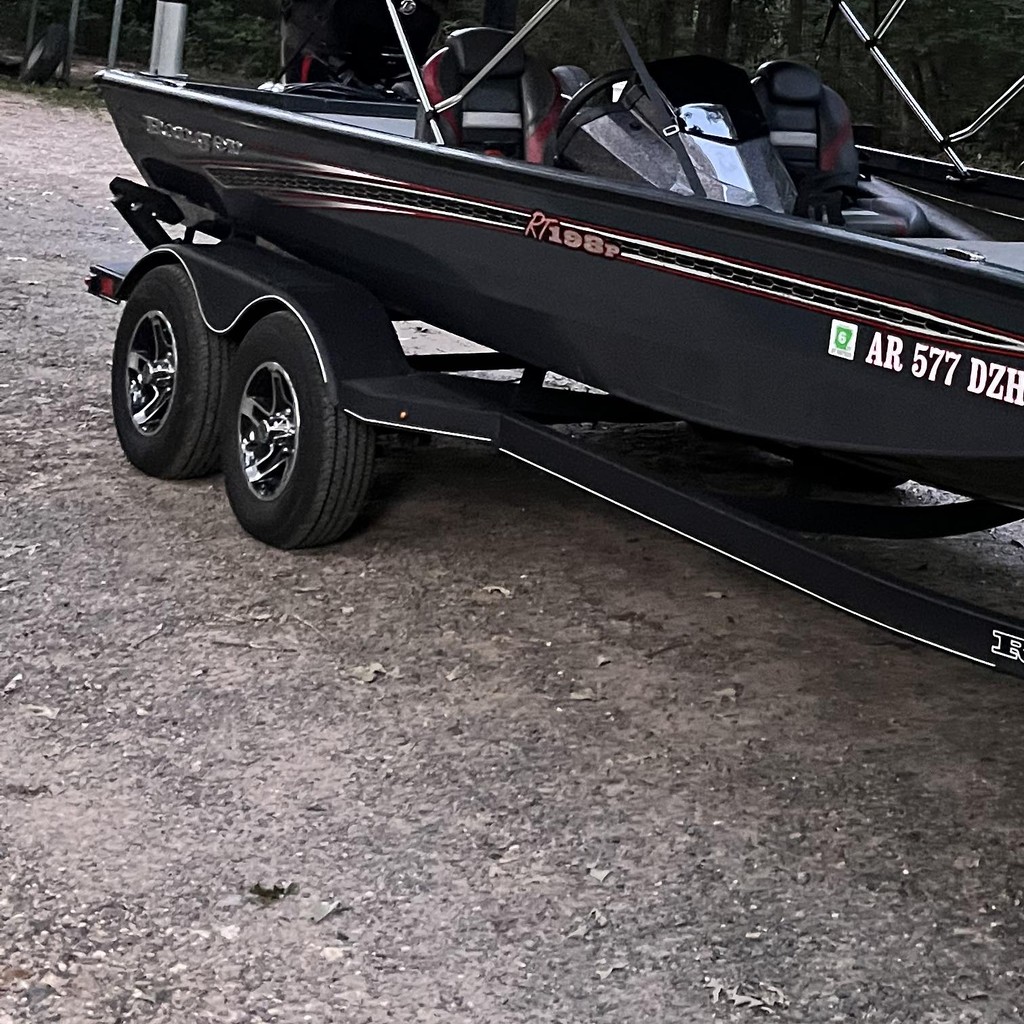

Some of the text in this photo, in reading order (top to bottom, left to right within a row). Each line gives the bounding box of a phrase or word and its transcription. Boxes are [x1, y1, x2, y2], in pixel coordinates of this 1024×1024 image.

[837, 330, 848, 345] 6
[865, 331, 904, 372] AR
[911, 341, 962, 387] 577
